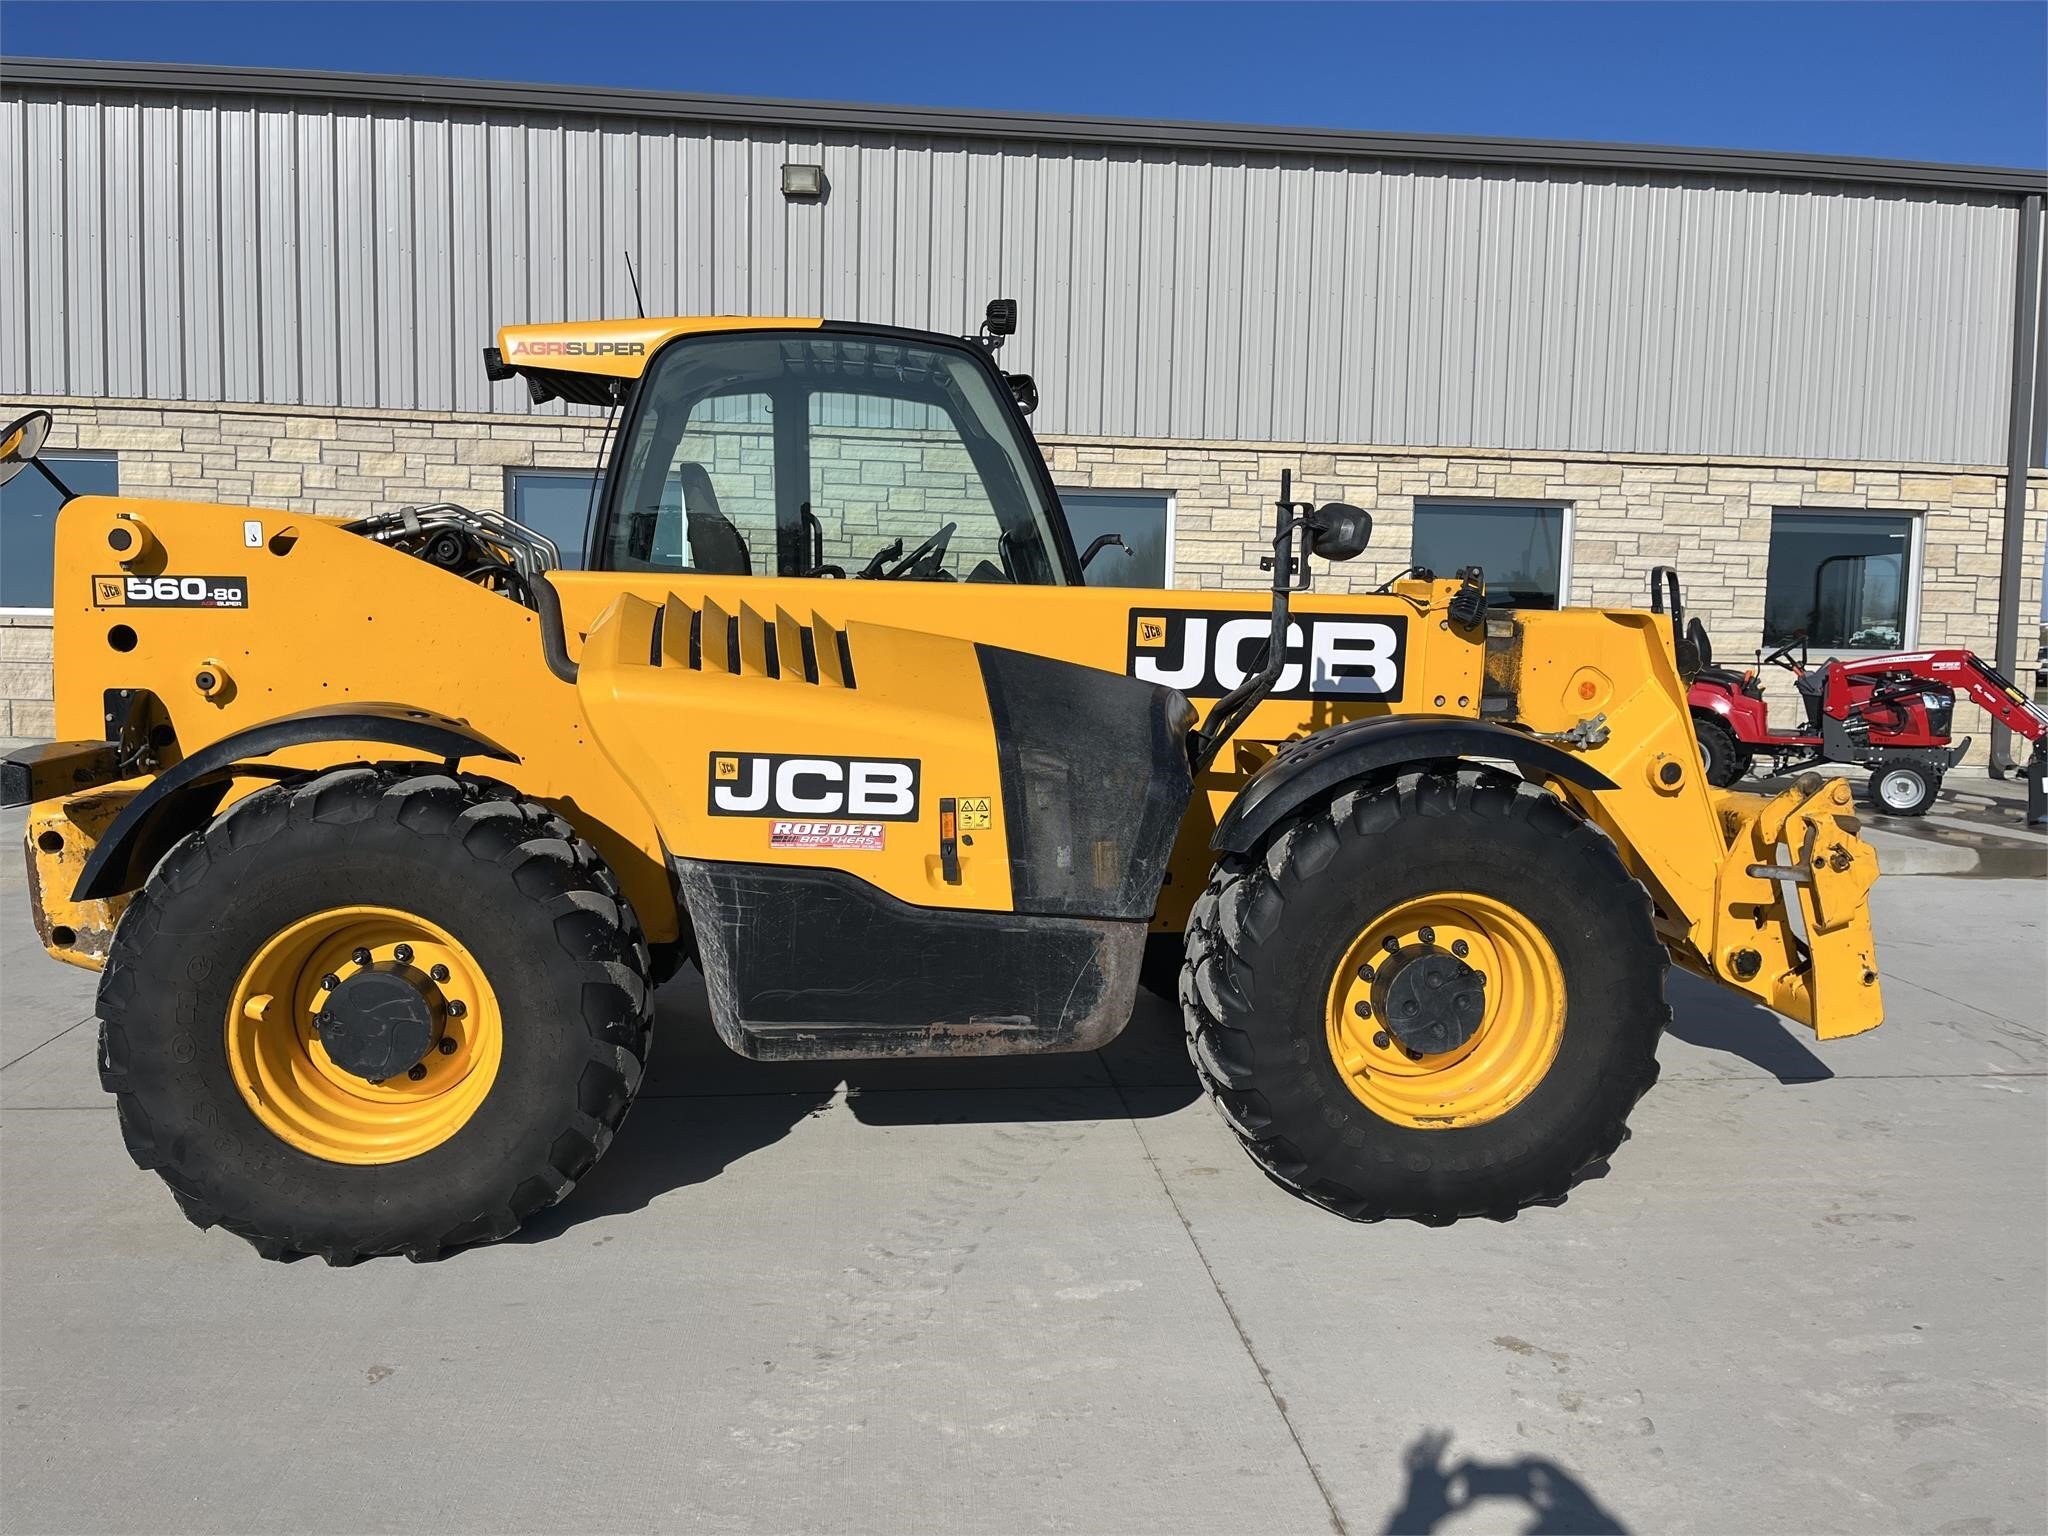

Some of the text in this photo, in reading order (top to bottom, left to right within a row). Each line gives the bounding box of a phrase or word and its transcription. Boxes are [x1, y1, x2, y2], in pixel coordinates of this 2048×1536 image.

[511, 341, 645, 356] AGRISUPER
[101, 584, 121, 598] JCB
[127, 577, 242, 600] 560-80
[1143, 624, 1161, 639] JCB
[1135, 618, 1397, 693] JCB
[714, 758, 914, 815] JCB
[773, 822, 883, 837] ROEDER
[799, 836, 875, 845] BROTHERS
